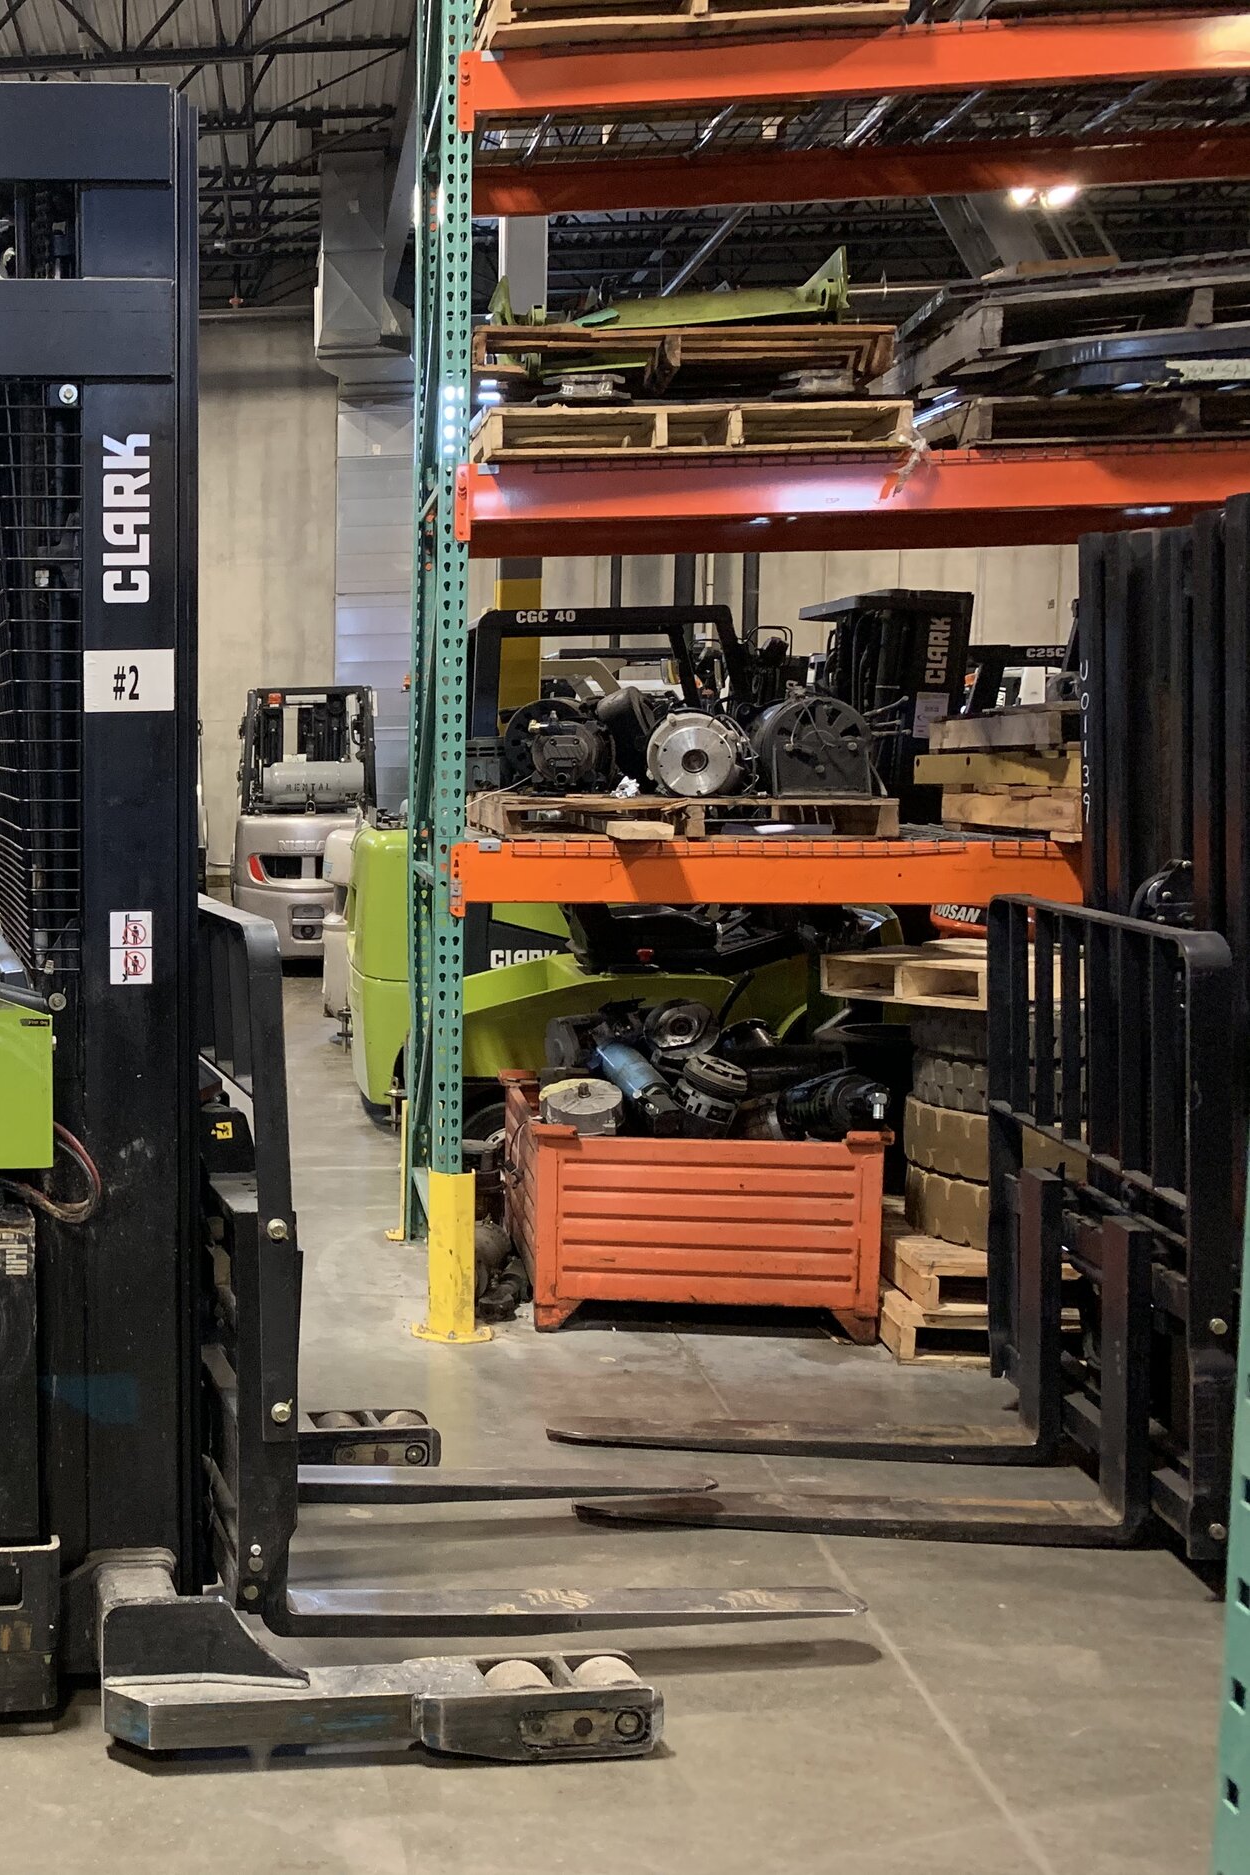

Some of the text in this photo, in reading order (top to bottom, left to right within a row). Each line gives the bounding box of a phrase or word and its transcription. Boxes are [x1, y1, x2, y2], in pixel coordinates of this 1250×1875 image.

[102, 433, 150, 604] CLARK
[515, 610, 576, 623] CGC 40
[924, 617, 951, 685] CLARK
[112, 665, 140, 701] #2
